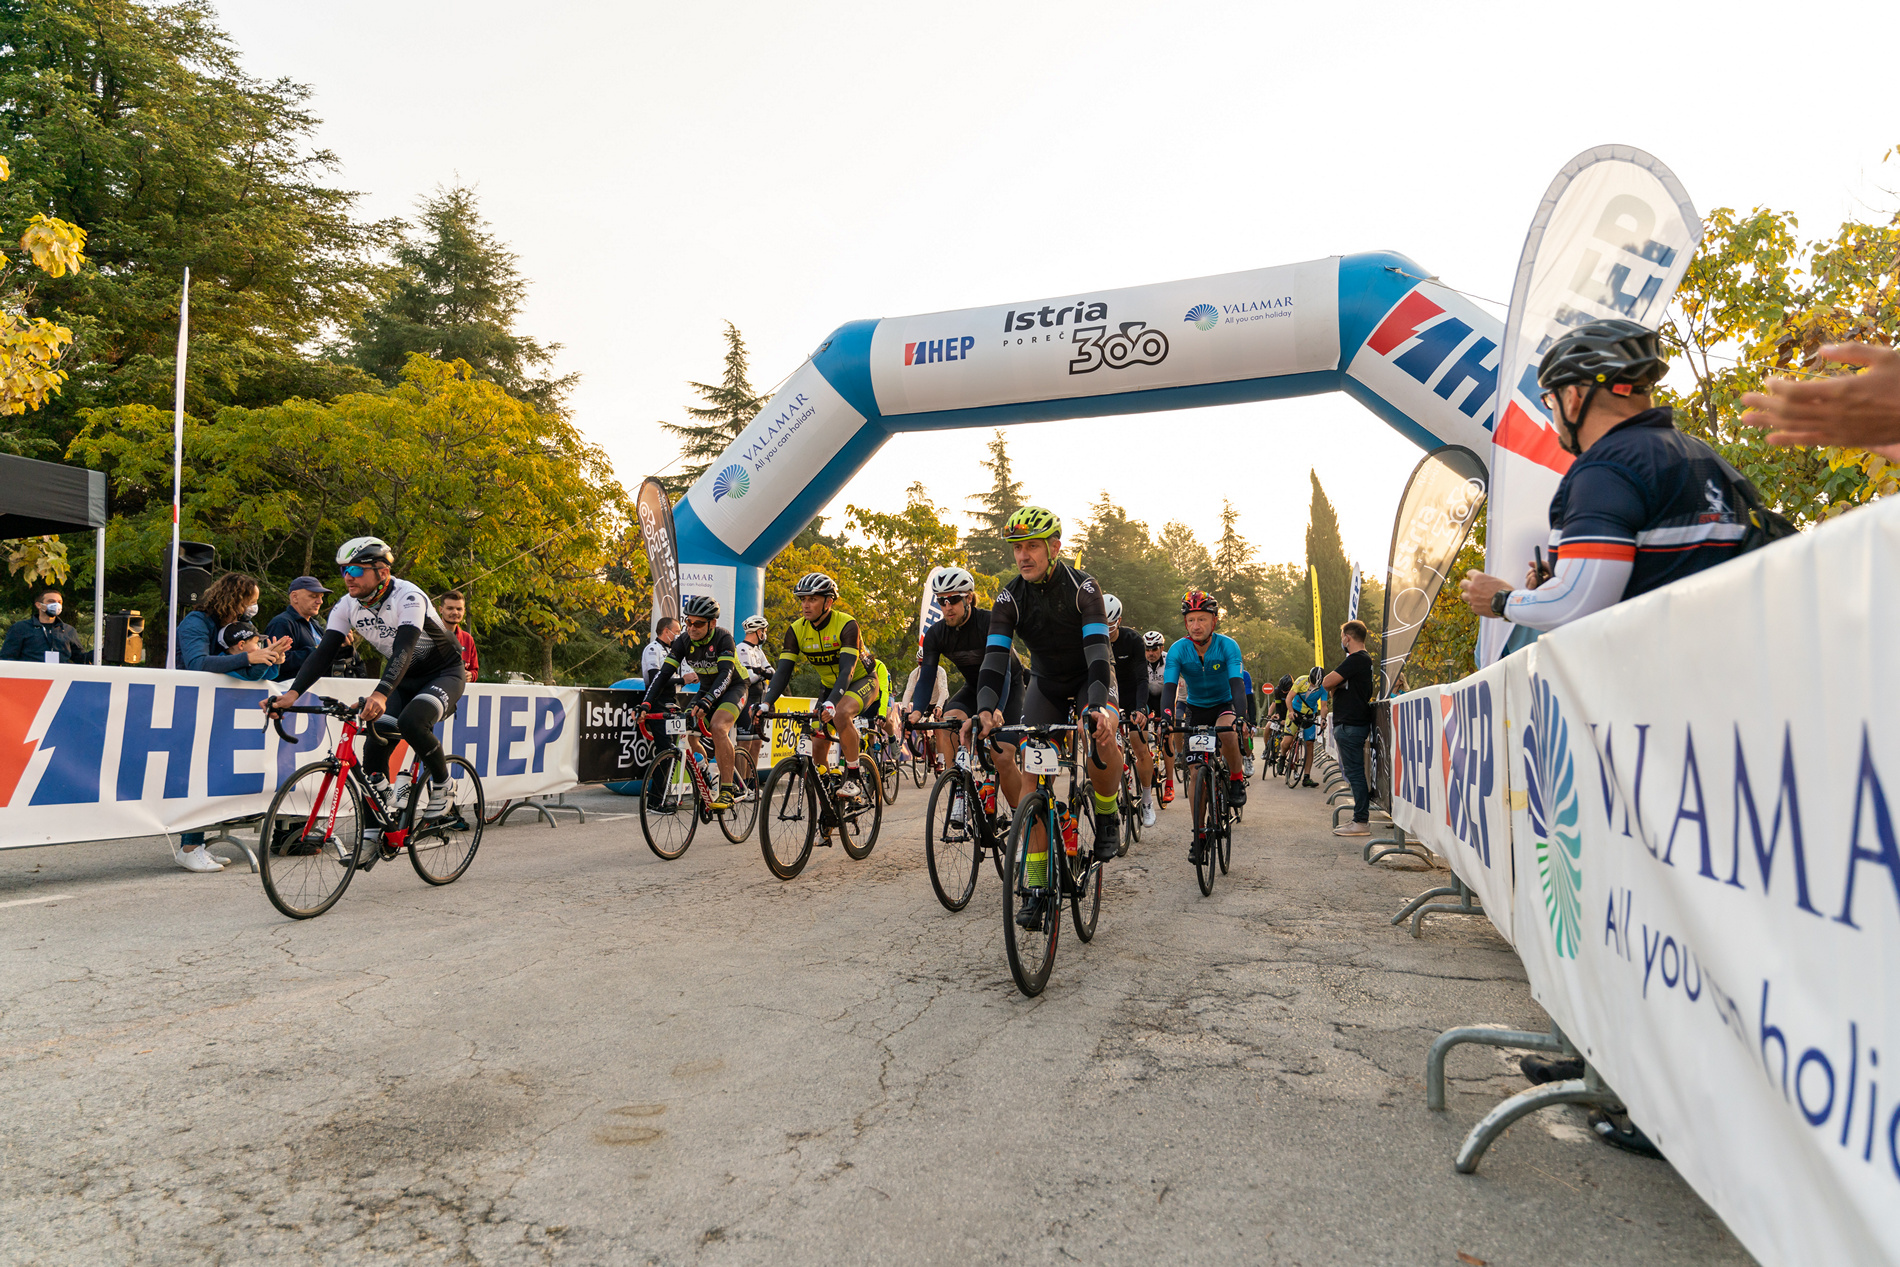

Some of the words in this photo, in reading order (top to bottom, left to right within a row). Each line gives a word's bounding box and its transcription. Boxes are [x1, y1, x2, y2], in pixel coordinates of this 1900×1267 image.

[1534, 193, 1678, 355] EP
[1003, 301, 1109, 333] Istria
[1222, 296, 1294, 315] VALAMAR
[1224, 317, 1235, 325] All
[1235, 316, 1249, 325] you
[1265, 311, 1292, 320] holiday
[928, 335, 975, 364] HEP
[1003, 331, 1065, 347] POREČ
[742, 393, 810, 462] VALAMAR
[754, 459, 766, 472] All
[764, 446, 778, 462] you
[777, 432, 792, 448] can
[788, 406, 816, 434] holiday
[1387, 505, 1438, 579] Istria
[451, 695, 567, 780] HEP
[585, 732, 618, 740] POREČ
[670, 719, 682, 730] 10
[775, 727, 801, 750] spor
[116, 683, 327, 801] HEP
[799, 739, 806, 750] 5
[1194, 735, 1210, 747] 23
[1404, 696, 1434, 814] HEP
[957, 752, 966, 763] 4
[1033, 750, 1043, 765] 3
[1456, 680, 1495, 870] HEP
[328, 787, 340, 829] COLNAGO
[1605, 886, 1632, 963] All
[1641, 923, 1702, 1003] you
[1759, 978, 1900, 1185] holi
